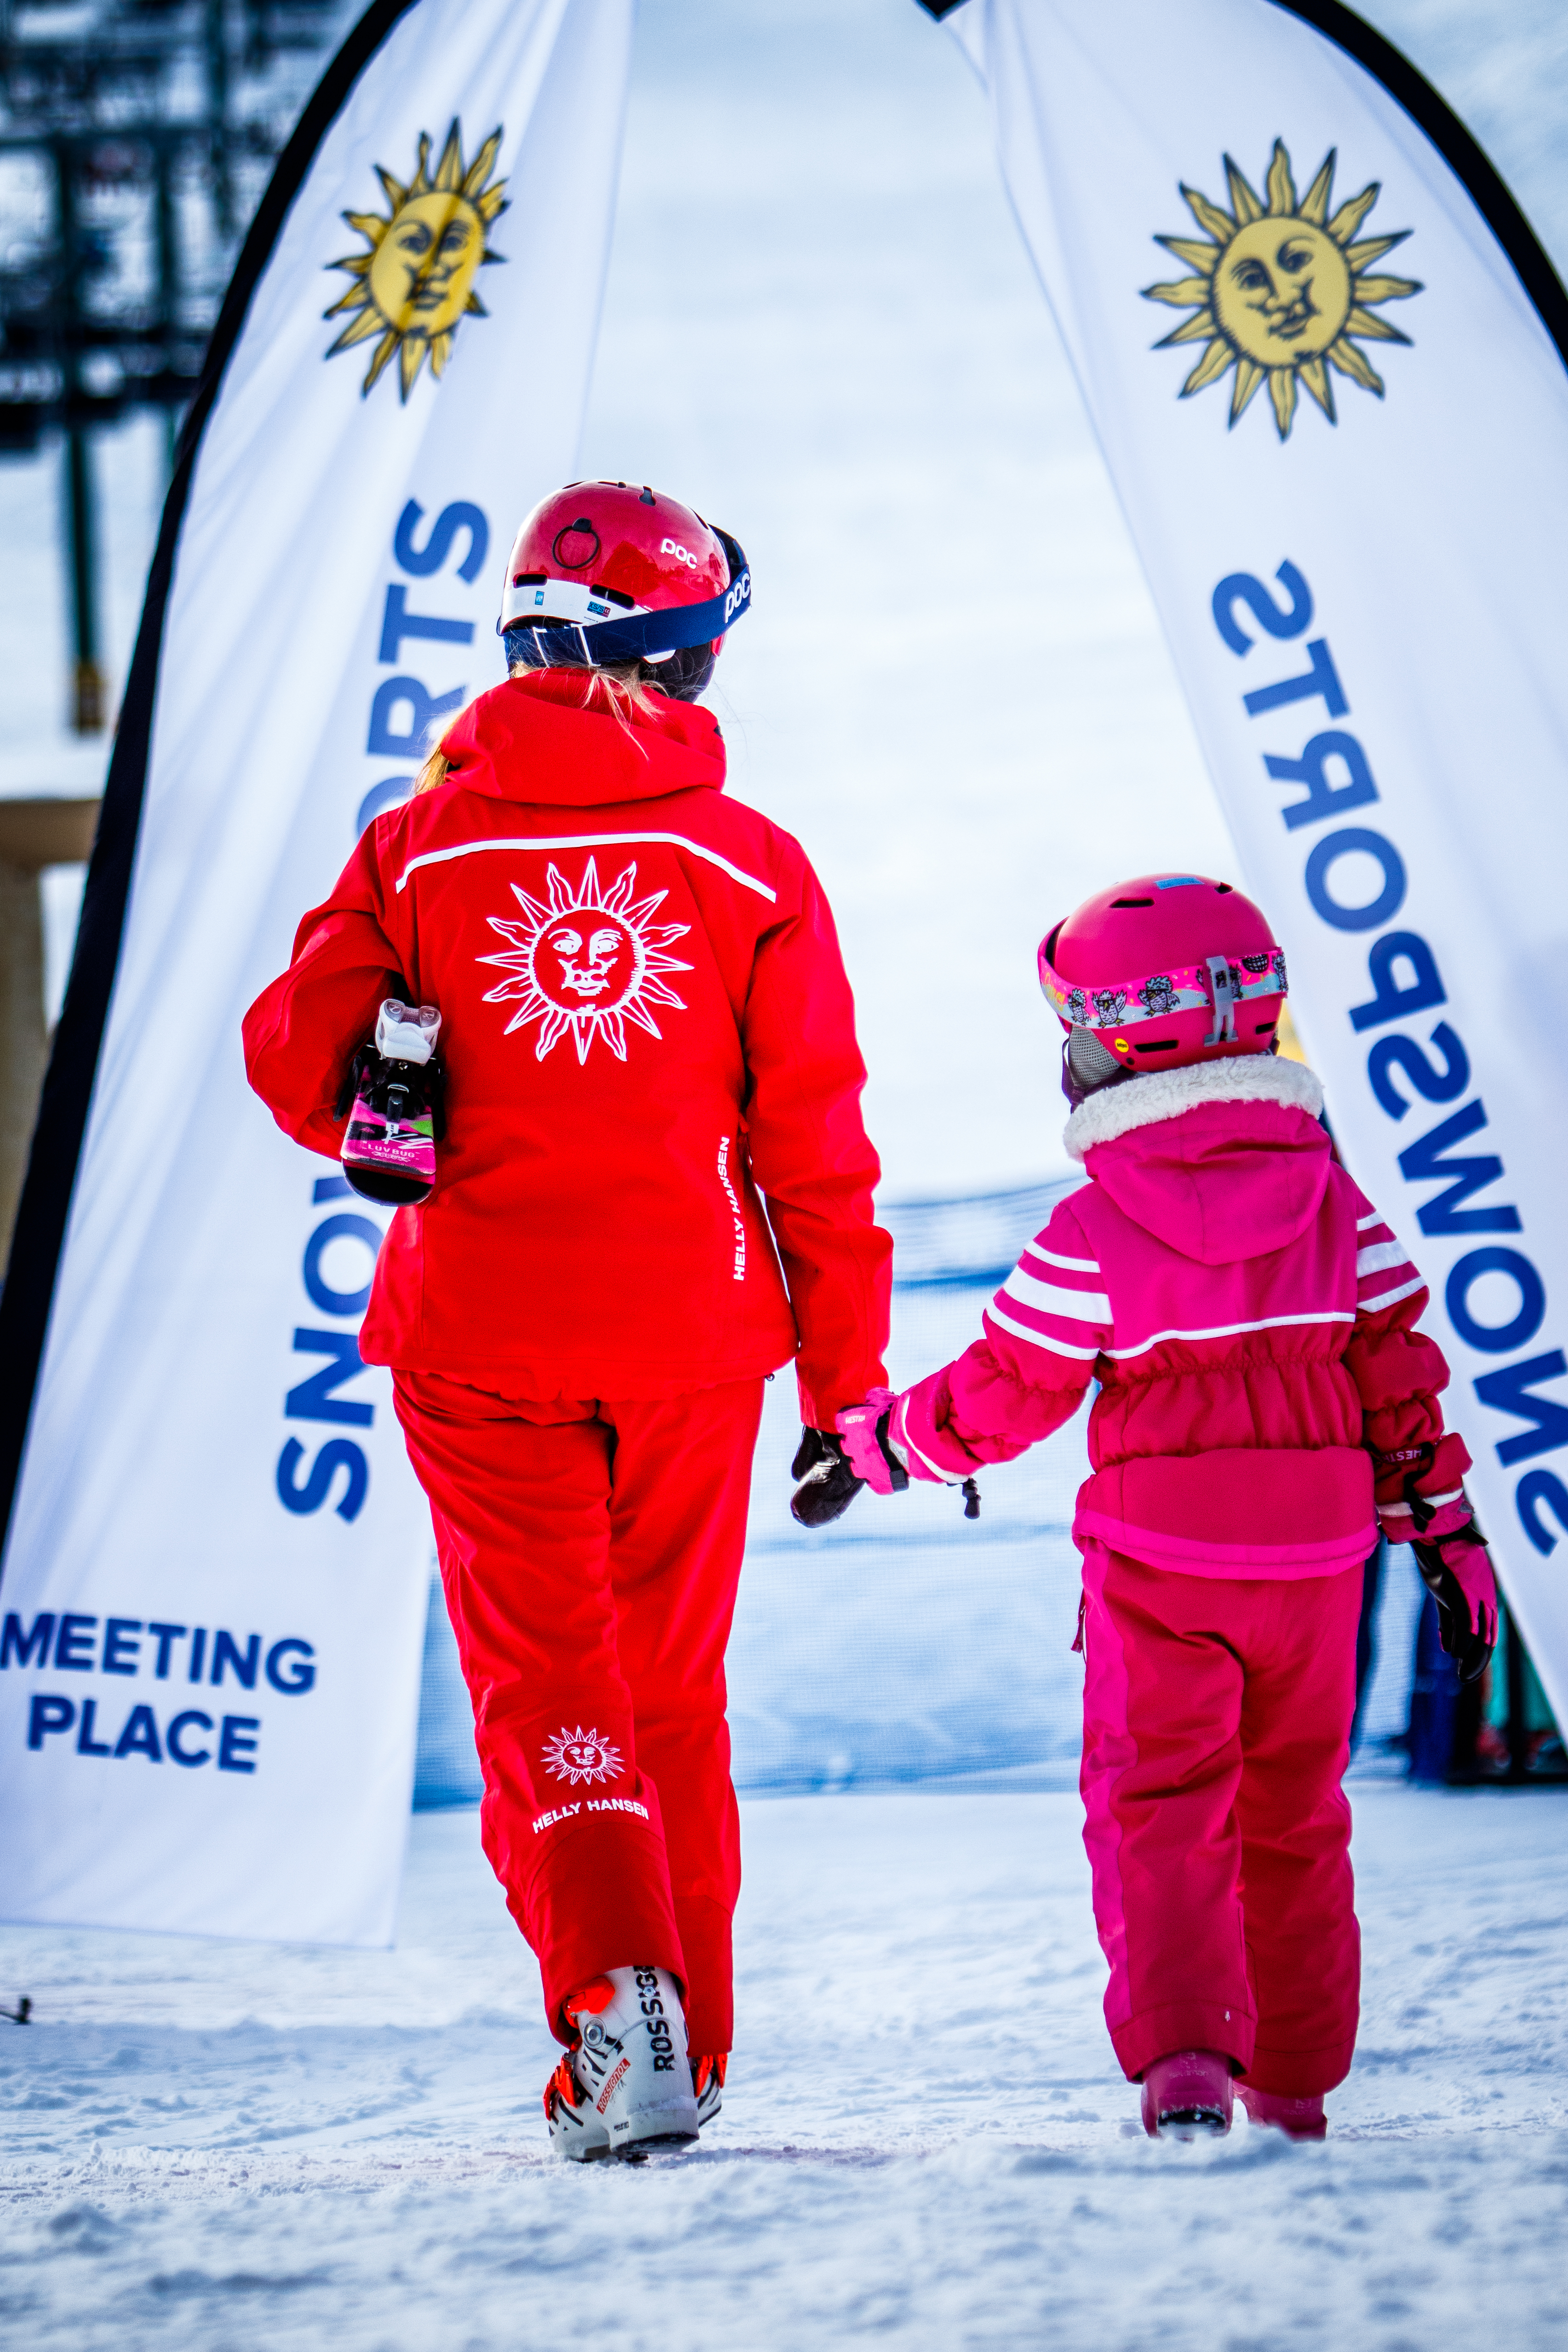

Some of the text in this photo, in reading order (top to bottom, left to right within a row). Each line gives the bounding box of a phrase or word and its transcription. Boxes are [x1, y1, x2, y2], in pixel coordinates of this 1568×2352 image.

[589, 601, 605, 612] XS/S
[274, 497, 491, 1525] SNORTS
[717, 1136, 745, 1281] HELLY HANSEN
[0, 1608, 317, 1697] MEETING
[24, 1691, 261, 1775] PLACE
[532, 1798, 649, 1834] HELLY HANSEN
[633, 1965, 675, 2072] ROSSIG
